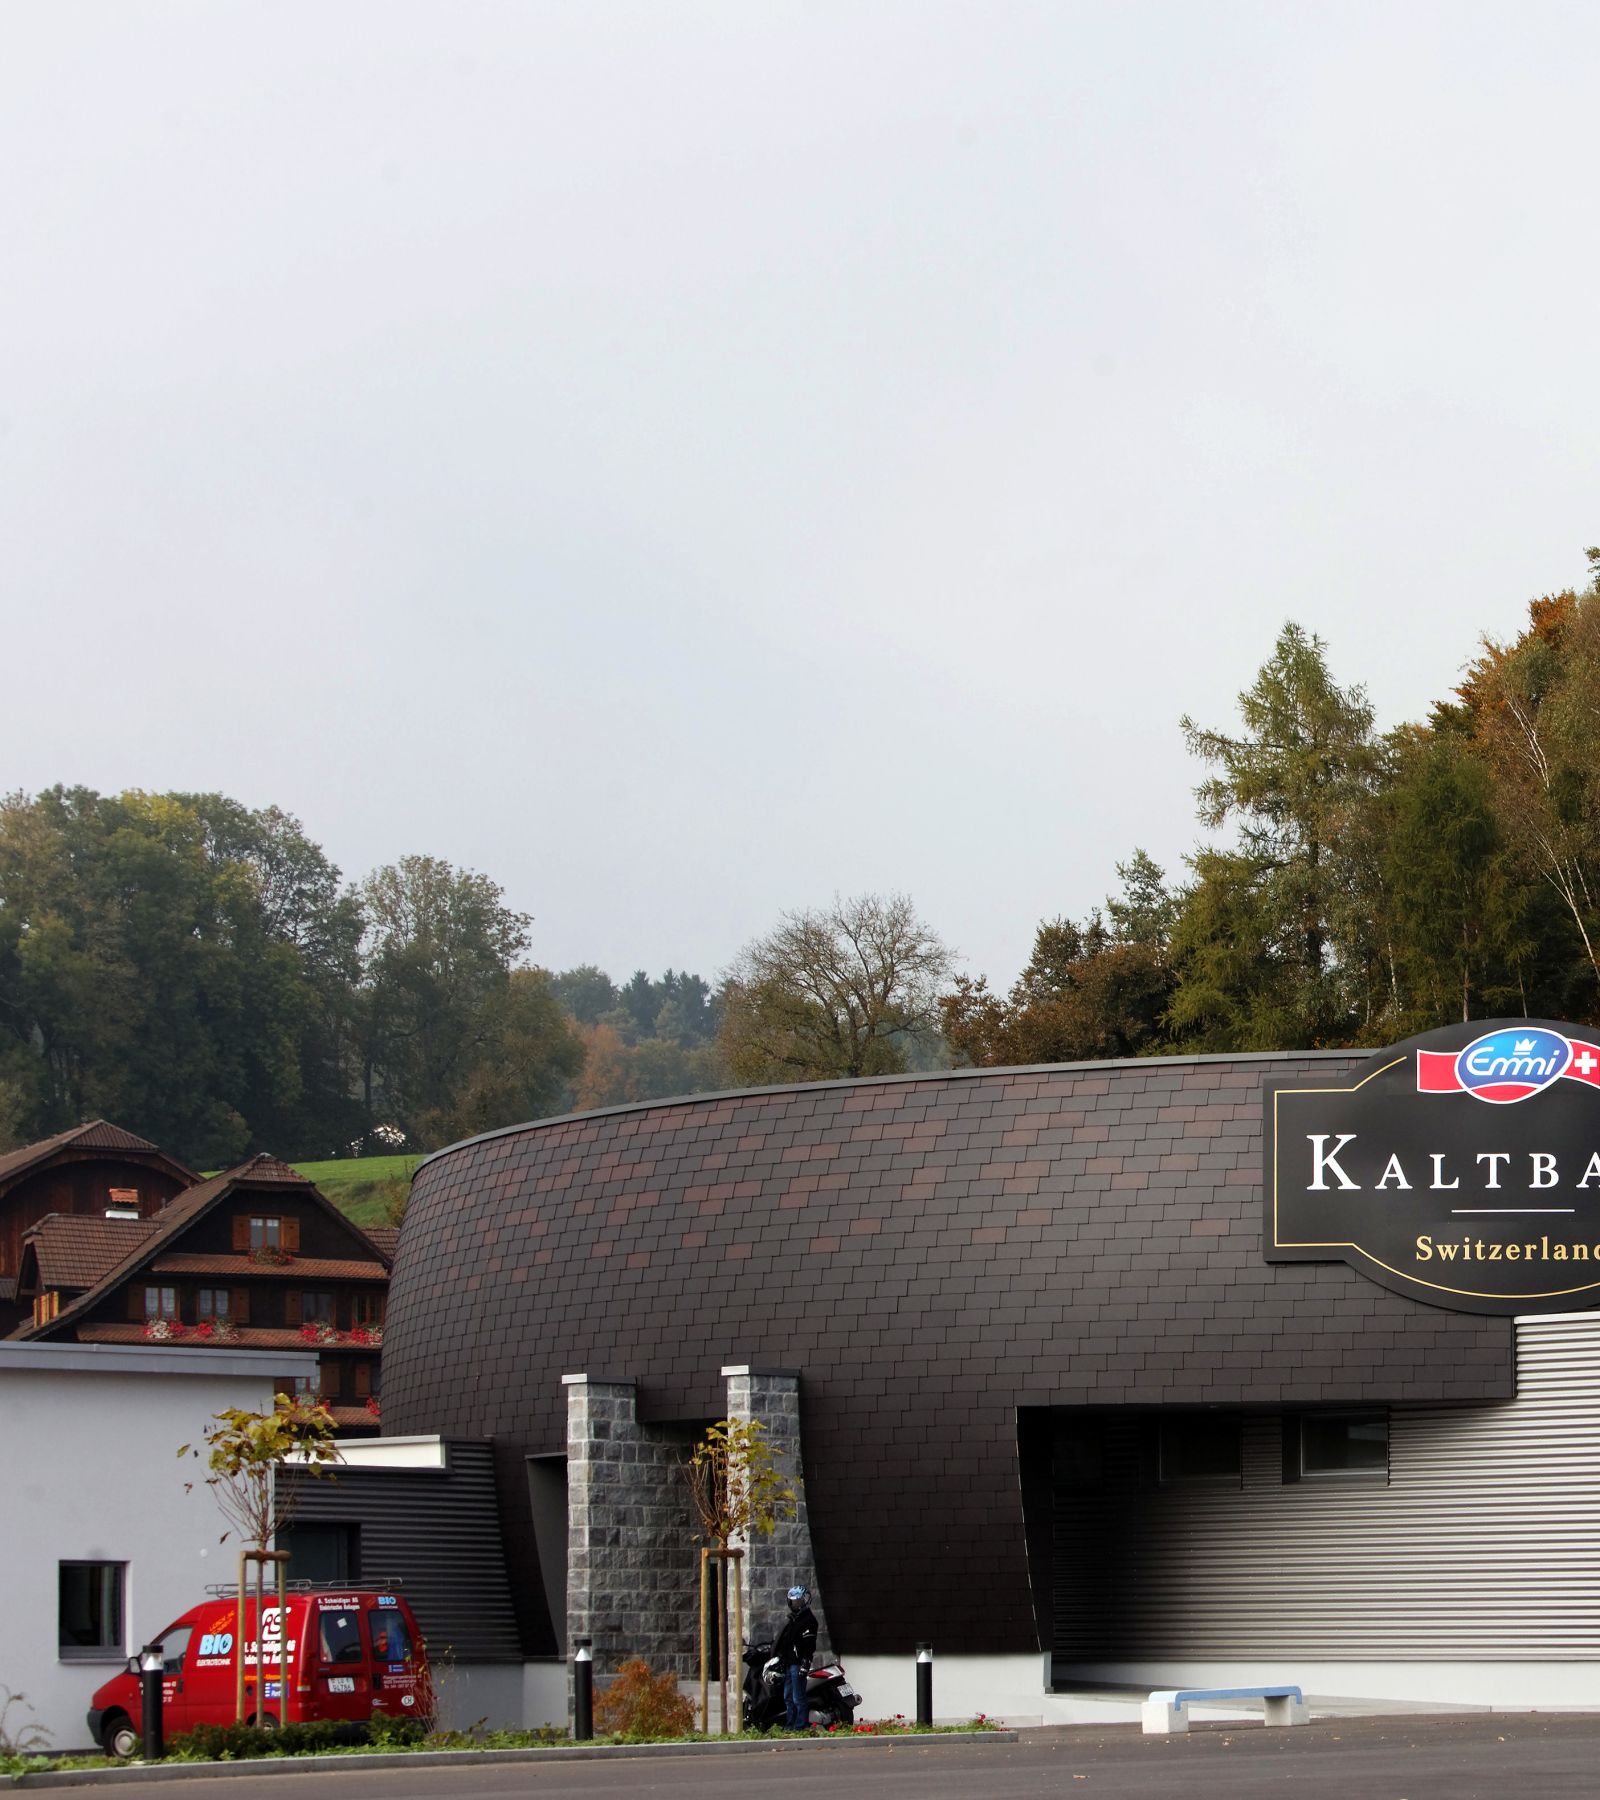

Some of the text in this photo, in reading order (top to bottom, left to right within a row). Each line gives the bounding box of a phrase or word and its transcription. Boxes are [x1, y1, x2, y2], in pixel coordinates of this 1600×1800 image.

[1466, 1047, 1559, 1077] Emmi
[378, 1596, 396, 1605] BIO
[199, 1633, 233, 1655] BIO
[403, 1696, 413, 1704] CH
